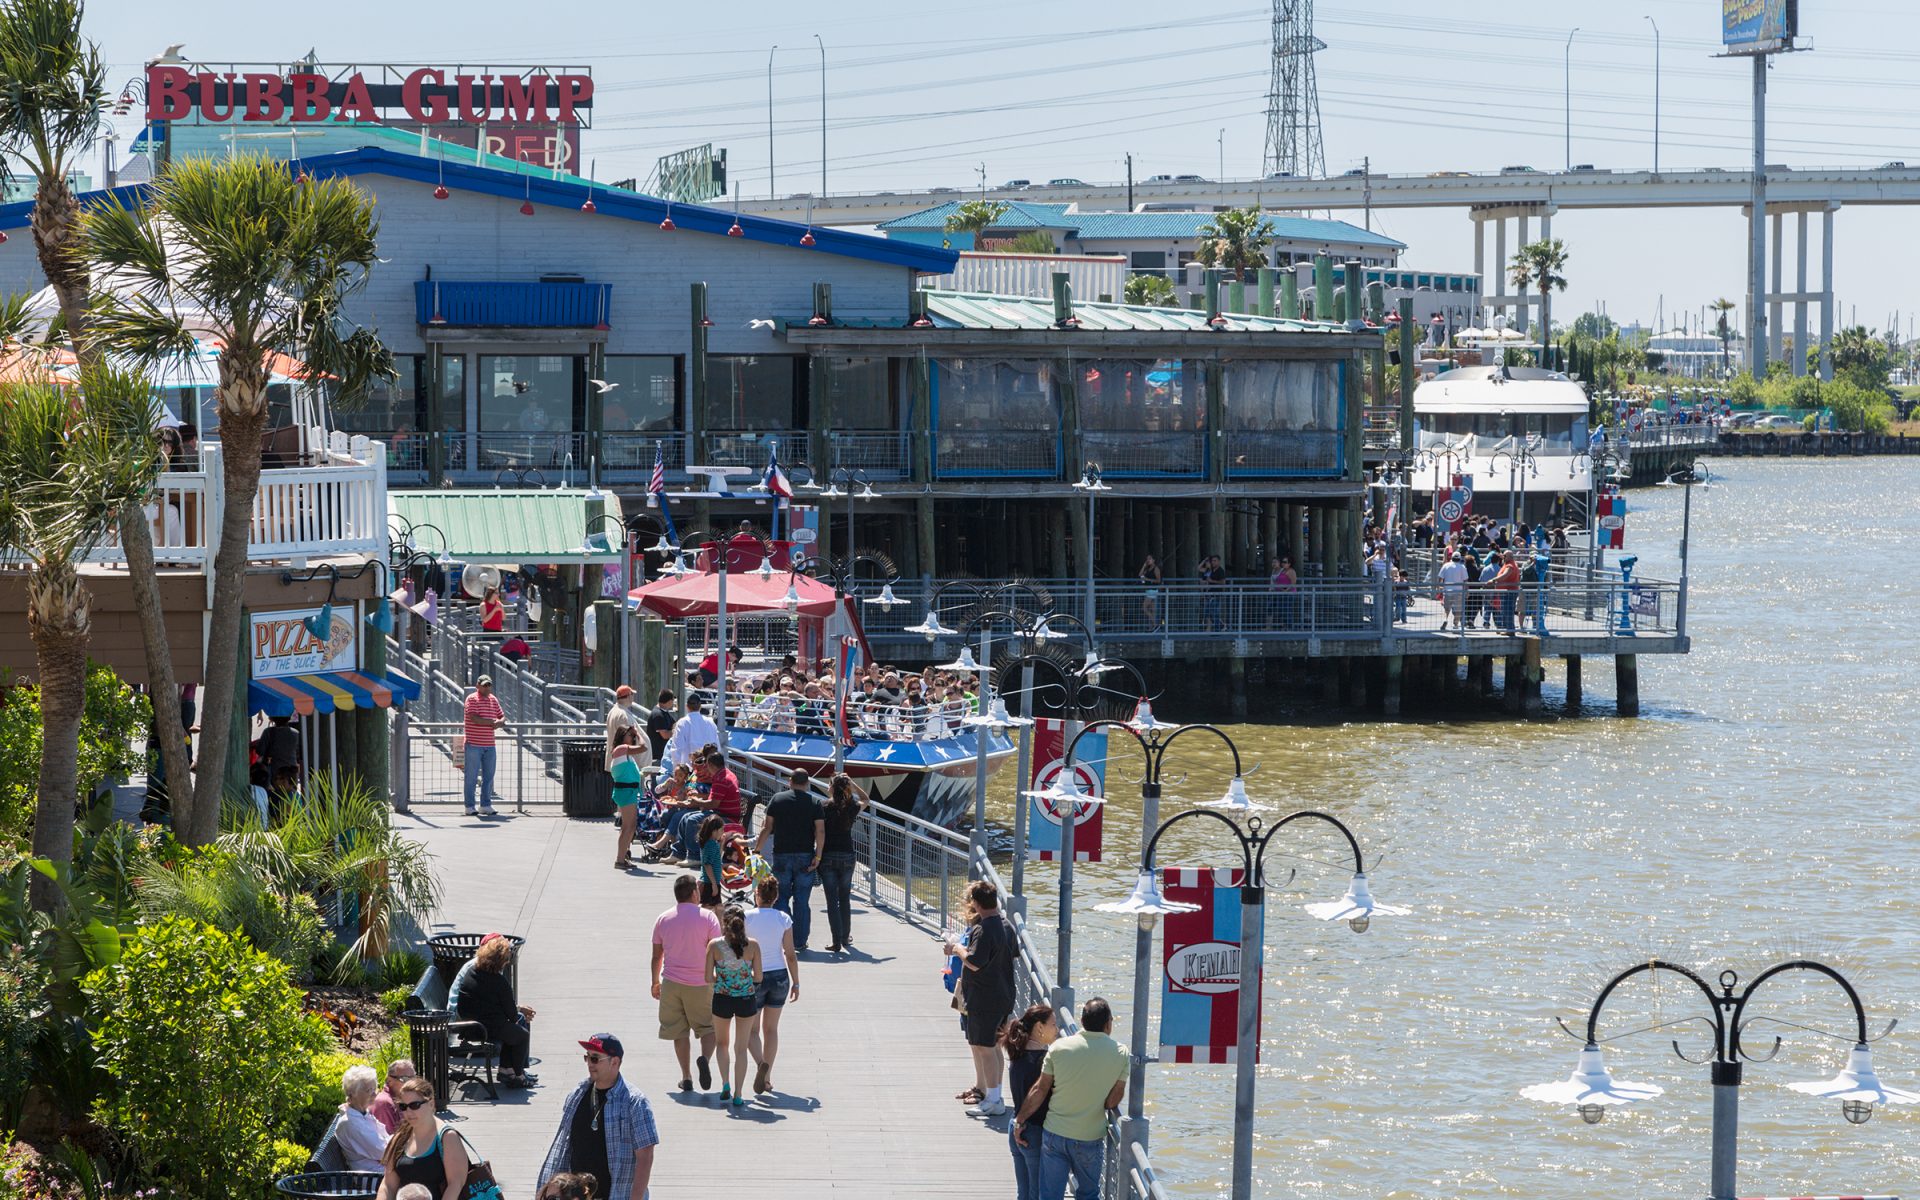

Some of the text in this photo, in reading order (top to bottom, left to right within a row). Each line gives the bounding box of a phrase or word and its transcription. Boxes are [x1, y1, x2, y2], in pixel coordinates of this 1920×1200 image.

[146, 66, 595, 123] BUBBA GUMP
[255, 619, 324, 659] PIZZA
[260, 657, 316, 672] BY THE SLICE
[1184, 949, 1240, 986] KEMAH
